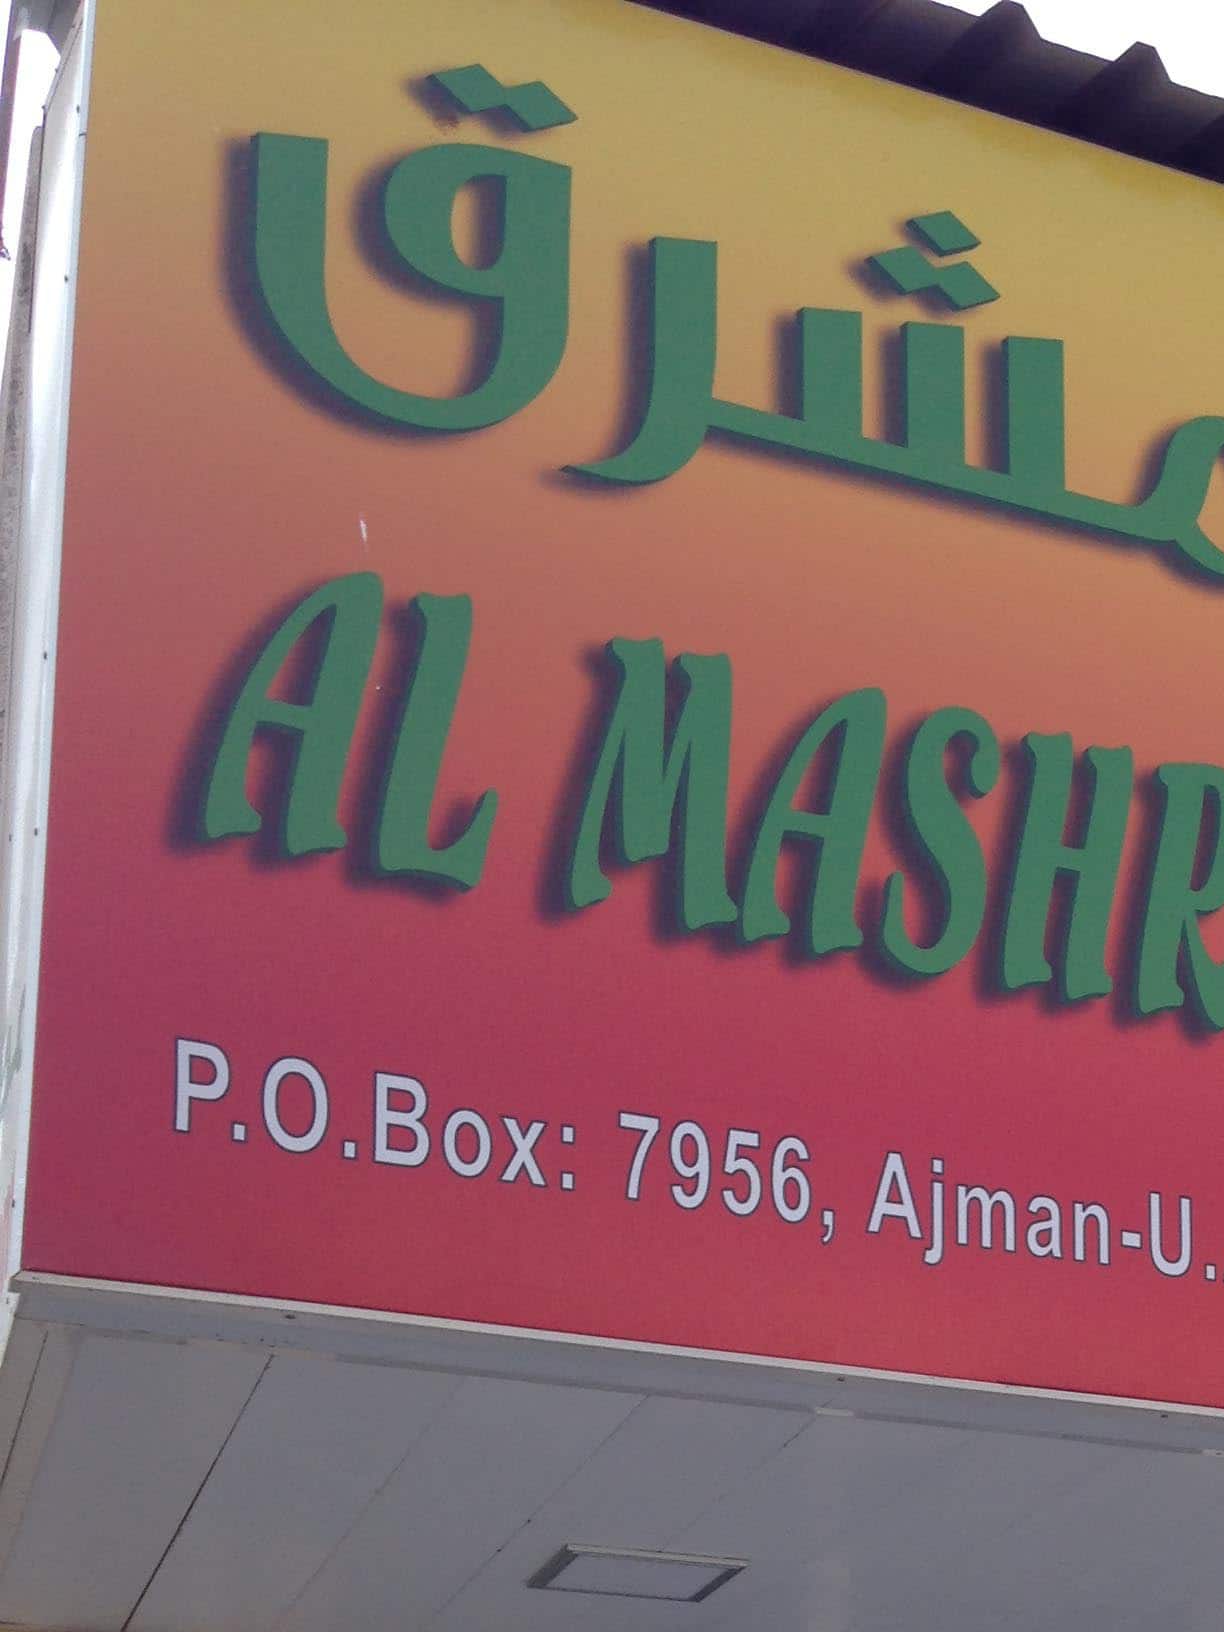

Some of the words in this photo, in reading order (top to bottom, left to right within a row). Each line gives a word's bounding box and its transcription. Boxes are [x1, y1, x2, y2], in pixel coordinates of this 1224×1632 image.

[204, 572, 498, 888] AL
[173, 1037, 577, 1191] P.O.Box:
[618, 1110, 836, 1244] 7956,
